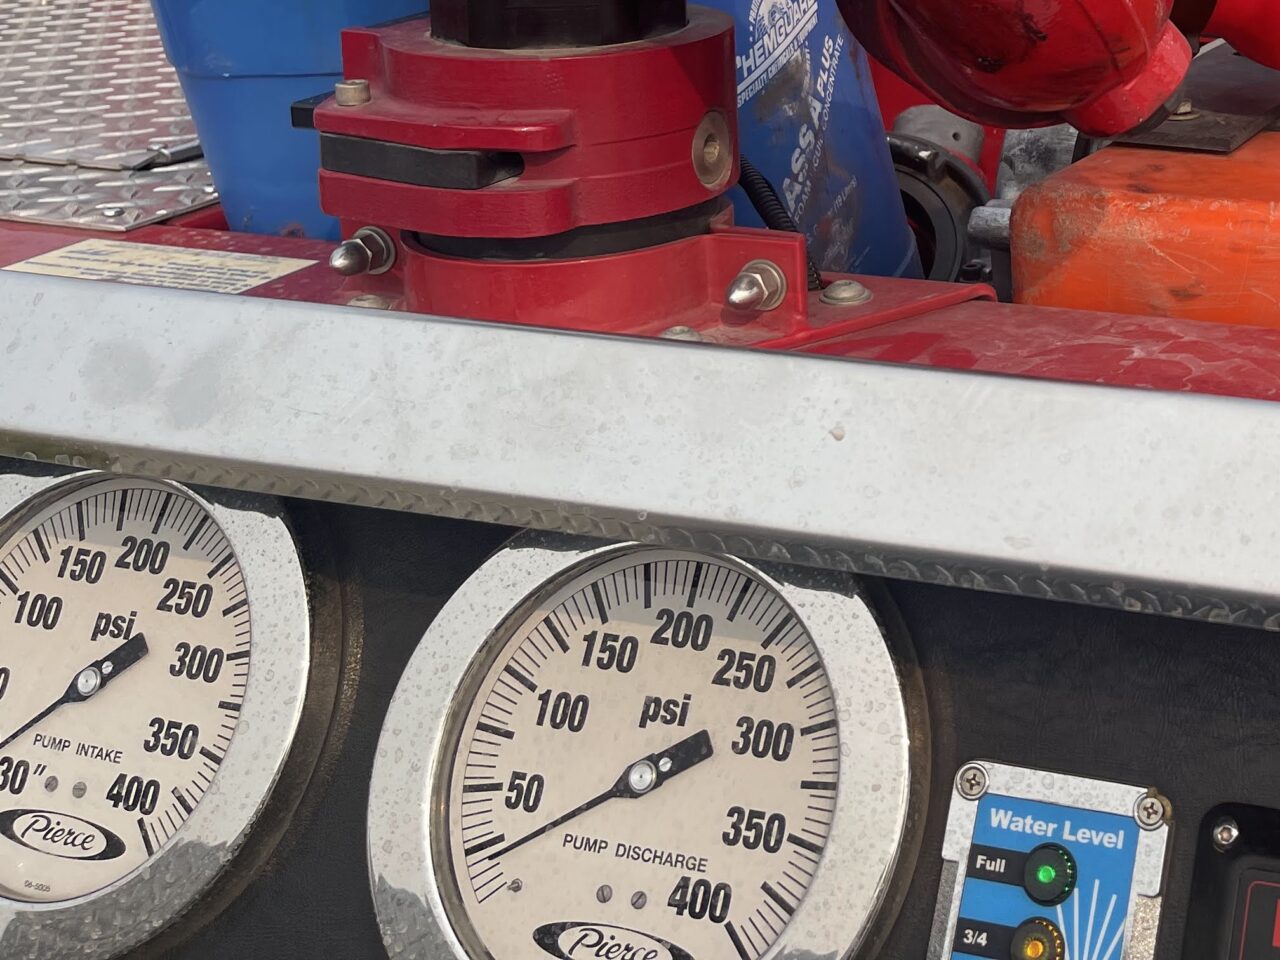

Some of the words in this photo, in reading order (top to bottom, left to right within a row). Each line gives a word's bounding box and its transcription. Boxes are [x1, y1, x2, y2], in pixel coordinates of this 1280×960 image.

[737, 71, 768, 109] SPECIALTY
[782, 123, 815, 217] ASS
[816, 35, 834, 98] PLUS
[794, 179, 812, 224] FOAM
[823, 33, 844, 131] CONCENTRATE
[57, 545, 106, 584] 150
[115, 536, 170, 574] 200
[14, 591, 63, 630] 100
[157, 578, 213, 618] 250
[92, 611, 137, 642] psi
[650, 608, 713, 651] 200
[169, 642, 225, 683] 300
[582, 630, 638, 673] 150
[711, 648, 776, 693] 250
[535, 689, 589, 732] 100
[638, 694, 692, 728] psi
[33, 733, 71, 752] PUMP
[75, 742, 123, 764] INTAKE
[144, 717, 200, 760] 350
[731, 716, 794, 762] 300
[105, 773, 160, 815] 400
[504, 771, 544, 812] 50
[20, 814, 96, 851] Pierce
[722, 806, 786, 853] 350
[990, 808, 1057, 837] Water
[1062, 820, 1125, 850] Level
[562, 833, 608, 854] PUMP
[615, 842, 708, 873] DISCHARGE
[976, 855, 1006, 873] Full
[667, 876, 732, 923] 400
[963, 929, 988, 947] 3/4
